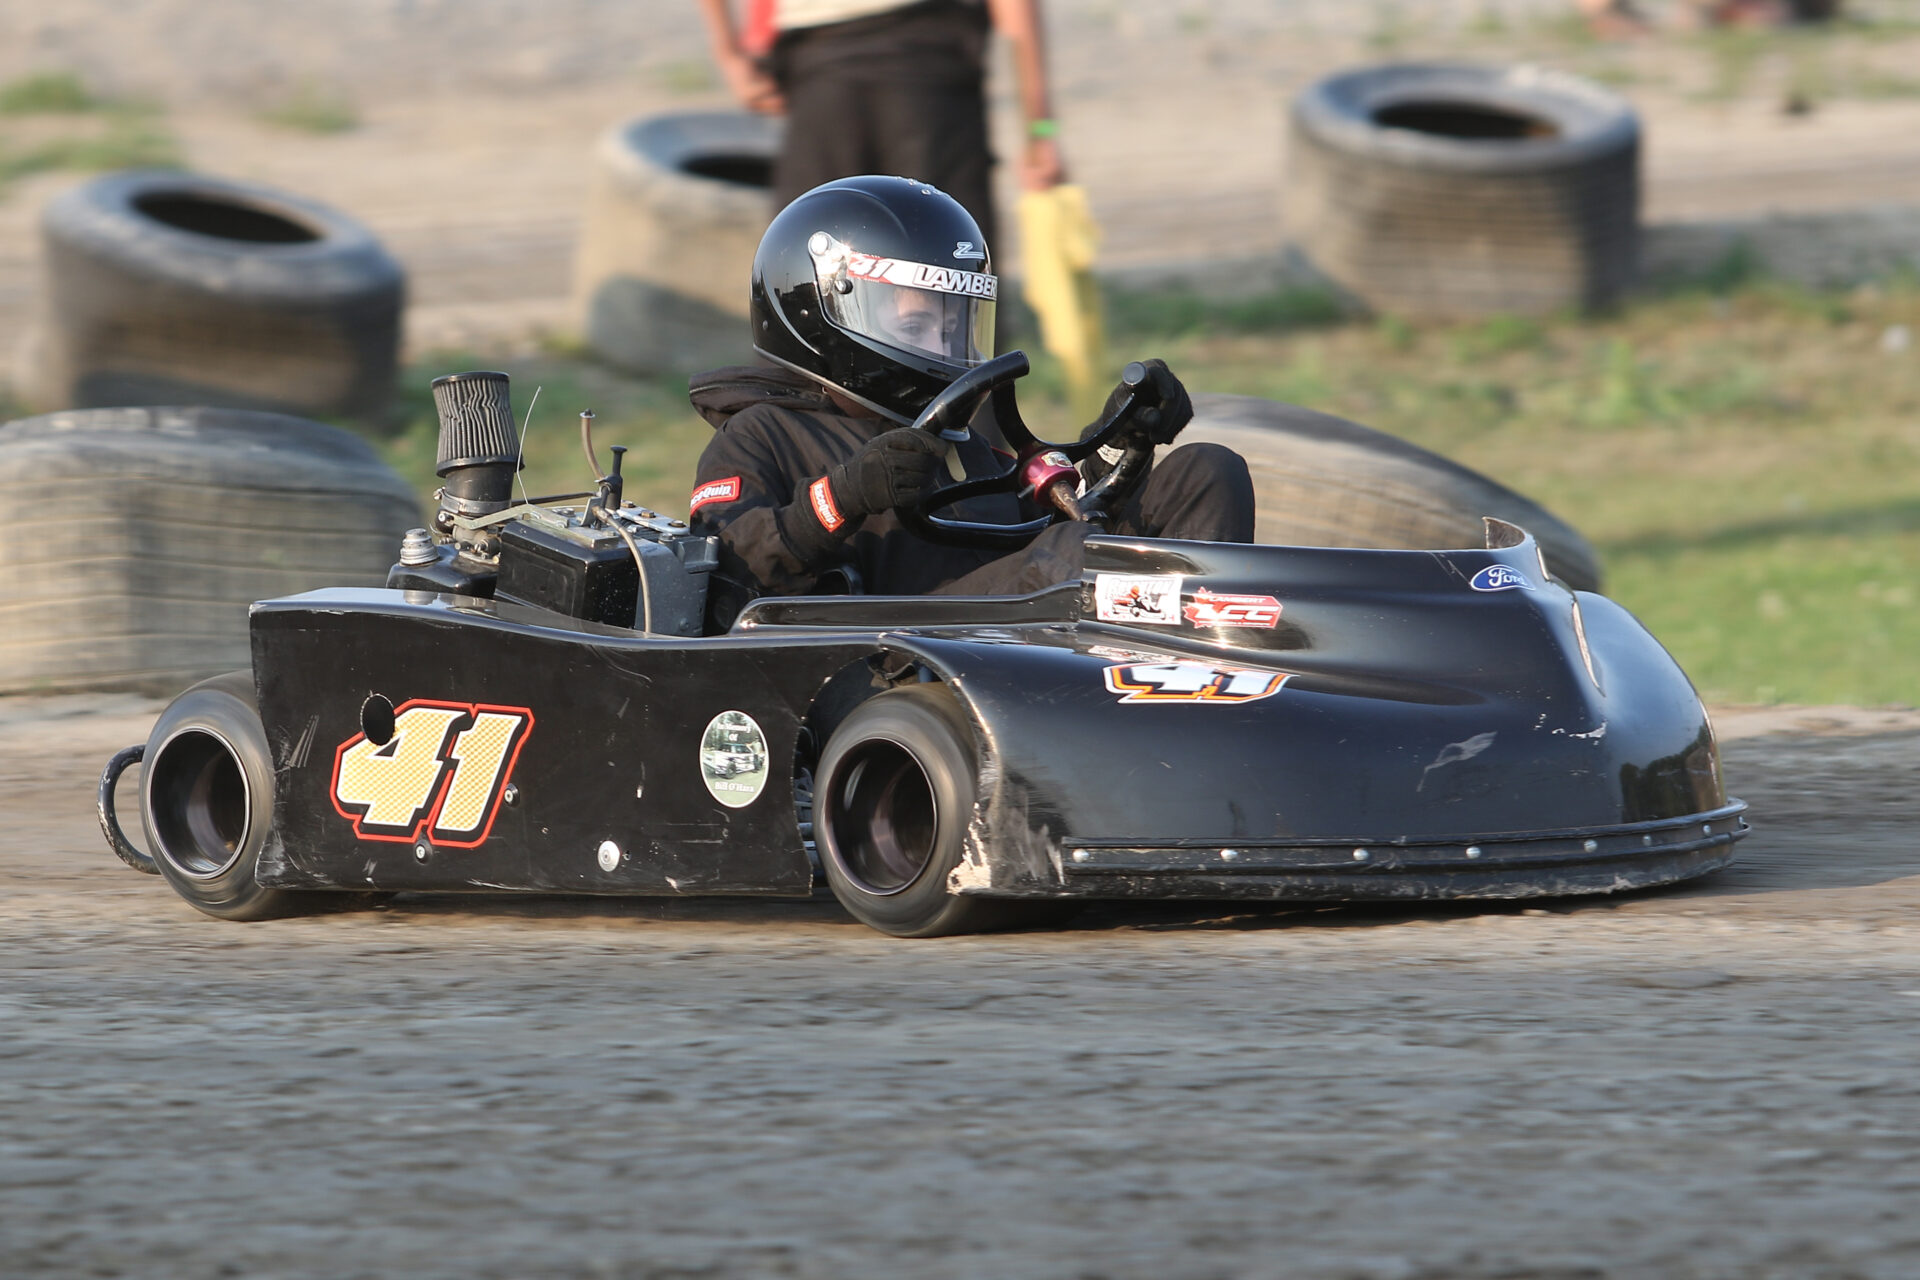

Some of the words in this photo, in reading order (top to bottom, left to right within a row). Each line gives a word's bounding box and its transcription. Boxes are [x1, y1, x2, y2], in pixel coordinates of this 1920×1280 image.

[848, 256, 894, 279] 41
[1488, 567, 1528, 587] Ford
[1122, 661, 1283, 697] 41
[334, 703, 529, 838] 41
